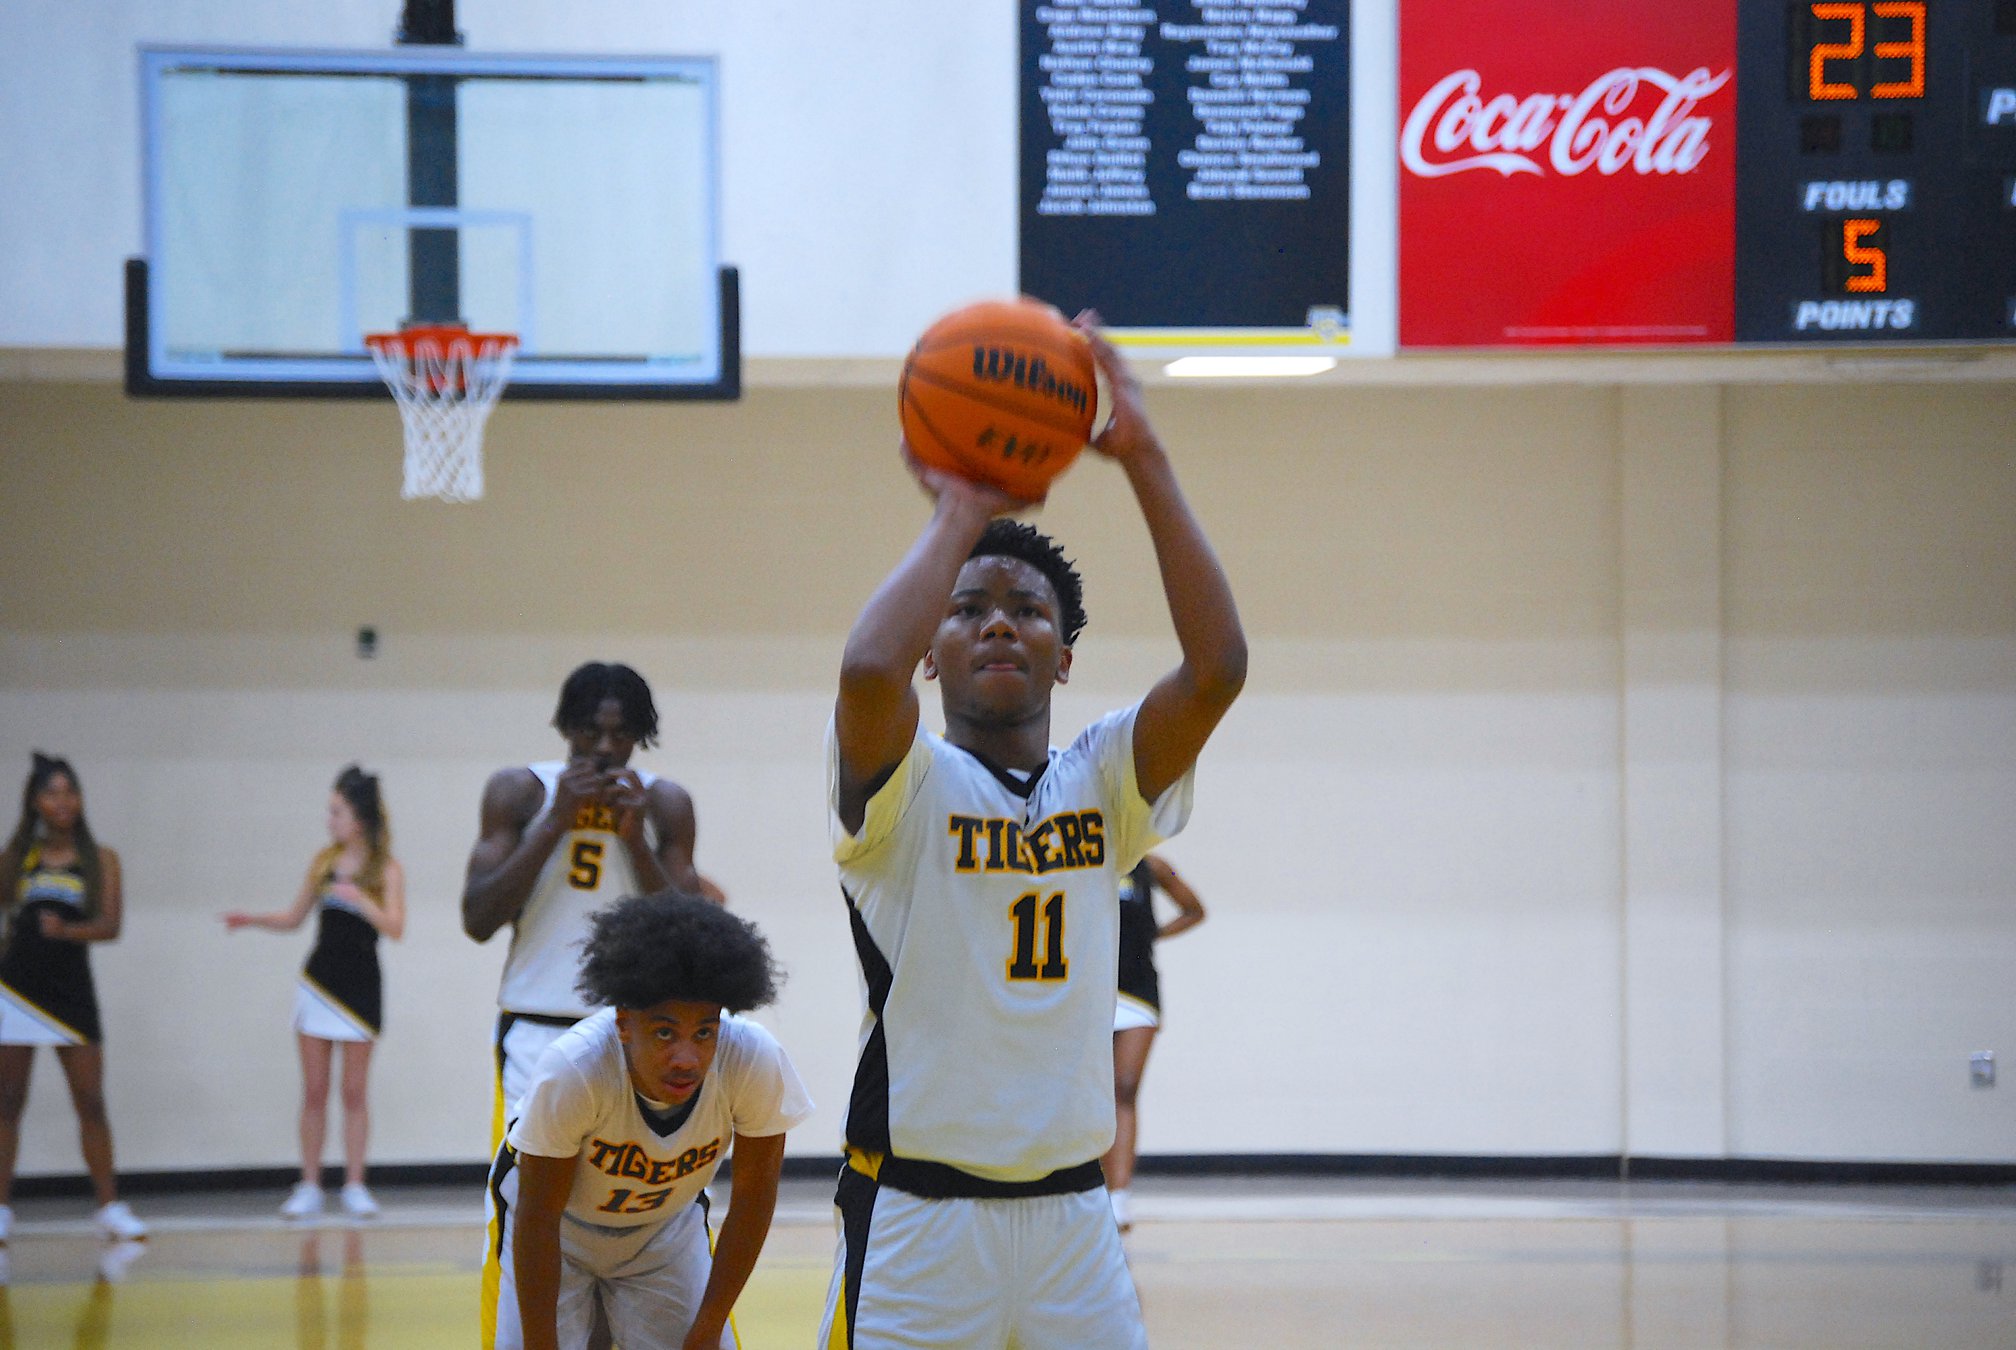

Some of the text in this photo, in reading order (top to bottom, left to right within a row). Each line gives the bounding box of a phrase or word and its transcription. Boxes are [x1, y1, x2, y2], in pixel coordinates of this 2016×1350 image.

[1809, 1, 1927, 100] 23
[1402, 68, 1731, 178] Coca-Cola
[1804, 179, 1908, 212] FOULS
[1843, 219, 1888, 292] 5
[1795, 299, 1915, 331] POINTS
[567, 839, 604, 892] 5
[948, 807, 1105, 876] TIGERS
[1005, 889, 1069, 982] 11
[589, 1137, 721, 1186] TIGERS
[597, 1187, 674, 1214] 13
